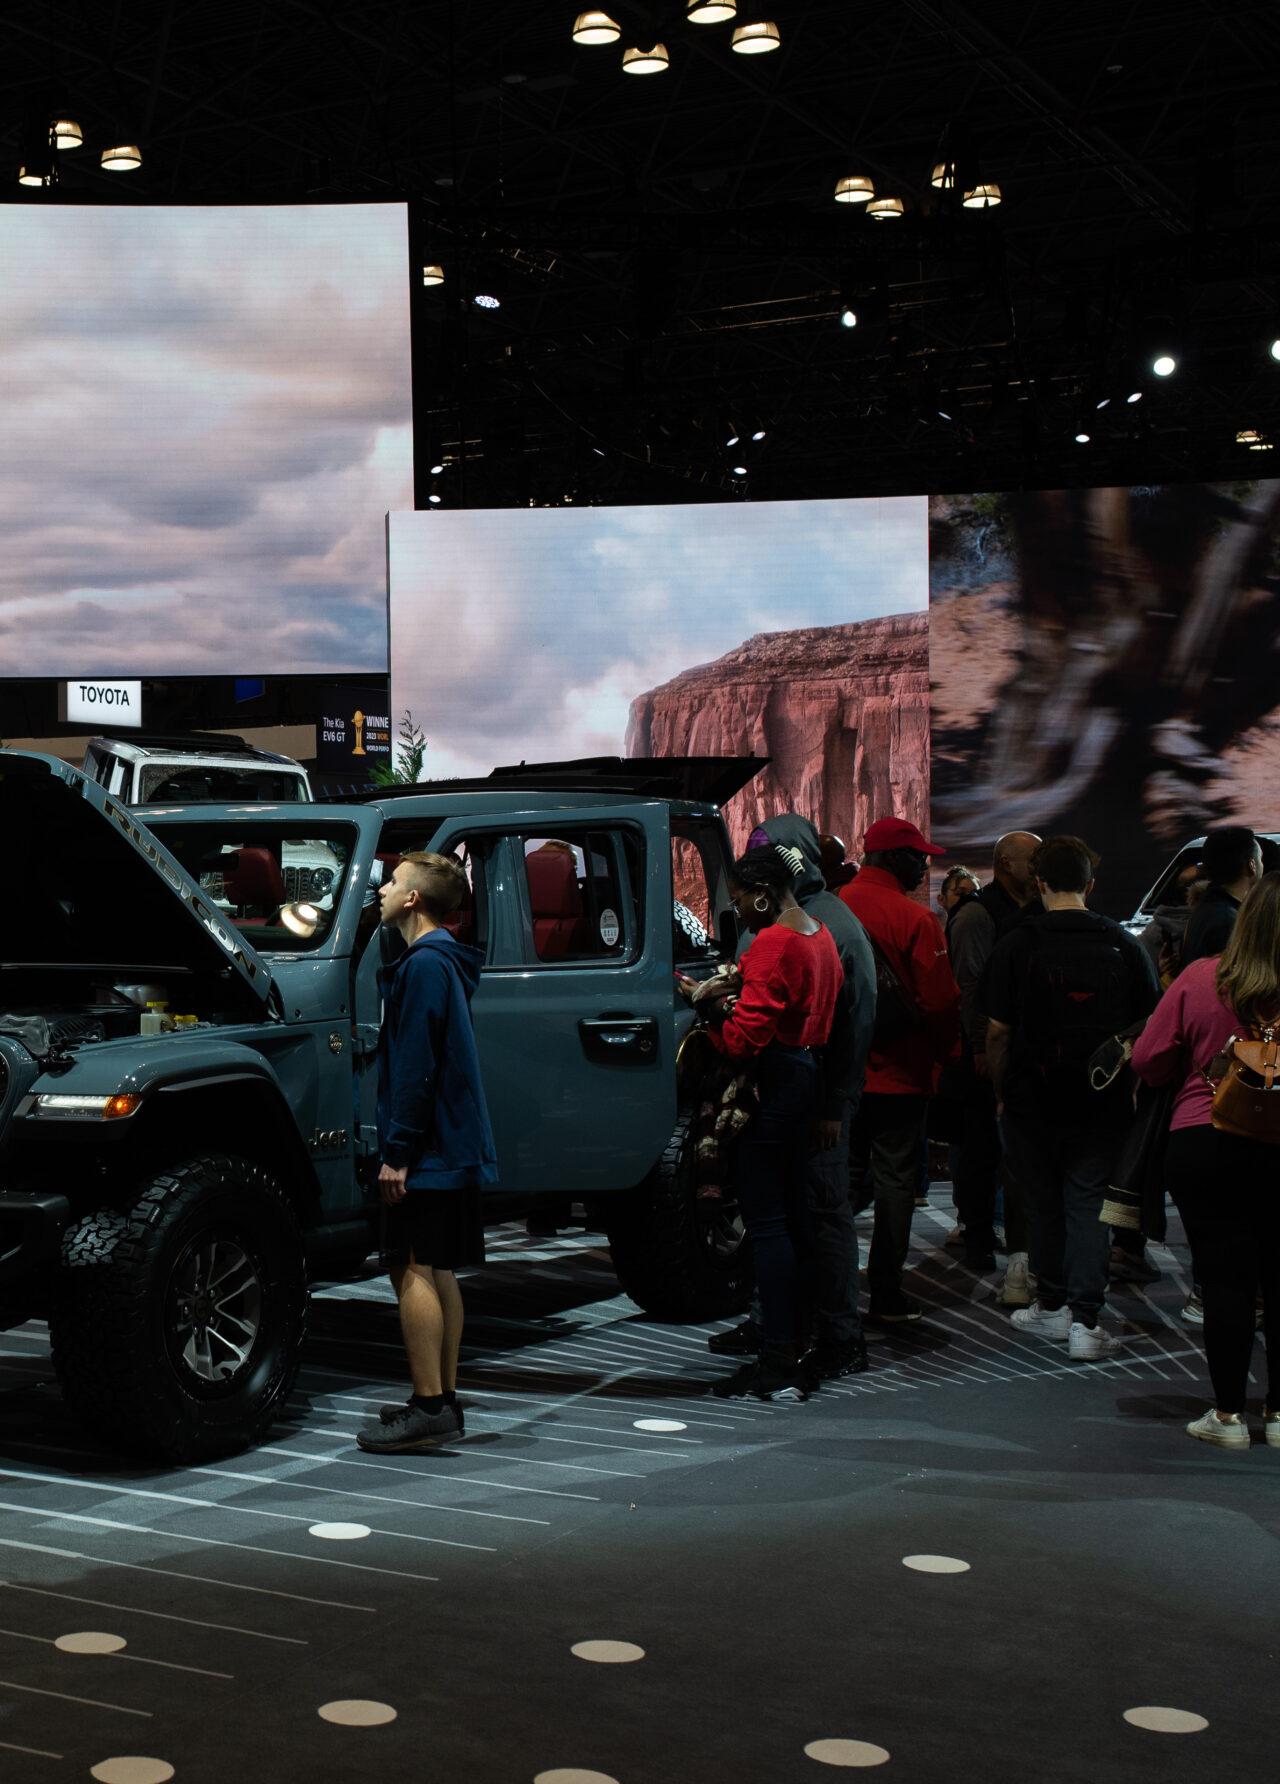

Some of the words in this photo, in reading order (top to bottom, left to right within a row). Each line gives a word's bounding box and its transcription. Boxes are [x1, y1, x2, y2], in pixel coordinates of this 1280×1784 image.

[79, 685, 130, 706] TOYOTA
[322, 716, 334, 728] The
[335, 718, 345, 728] Kia
[322, 730, 335, 741] EV6
[336, 731, 346, 742] GT
[103, 797, 258, 981] RUBICON
[308, 1128, 347, 1147] Jeep
